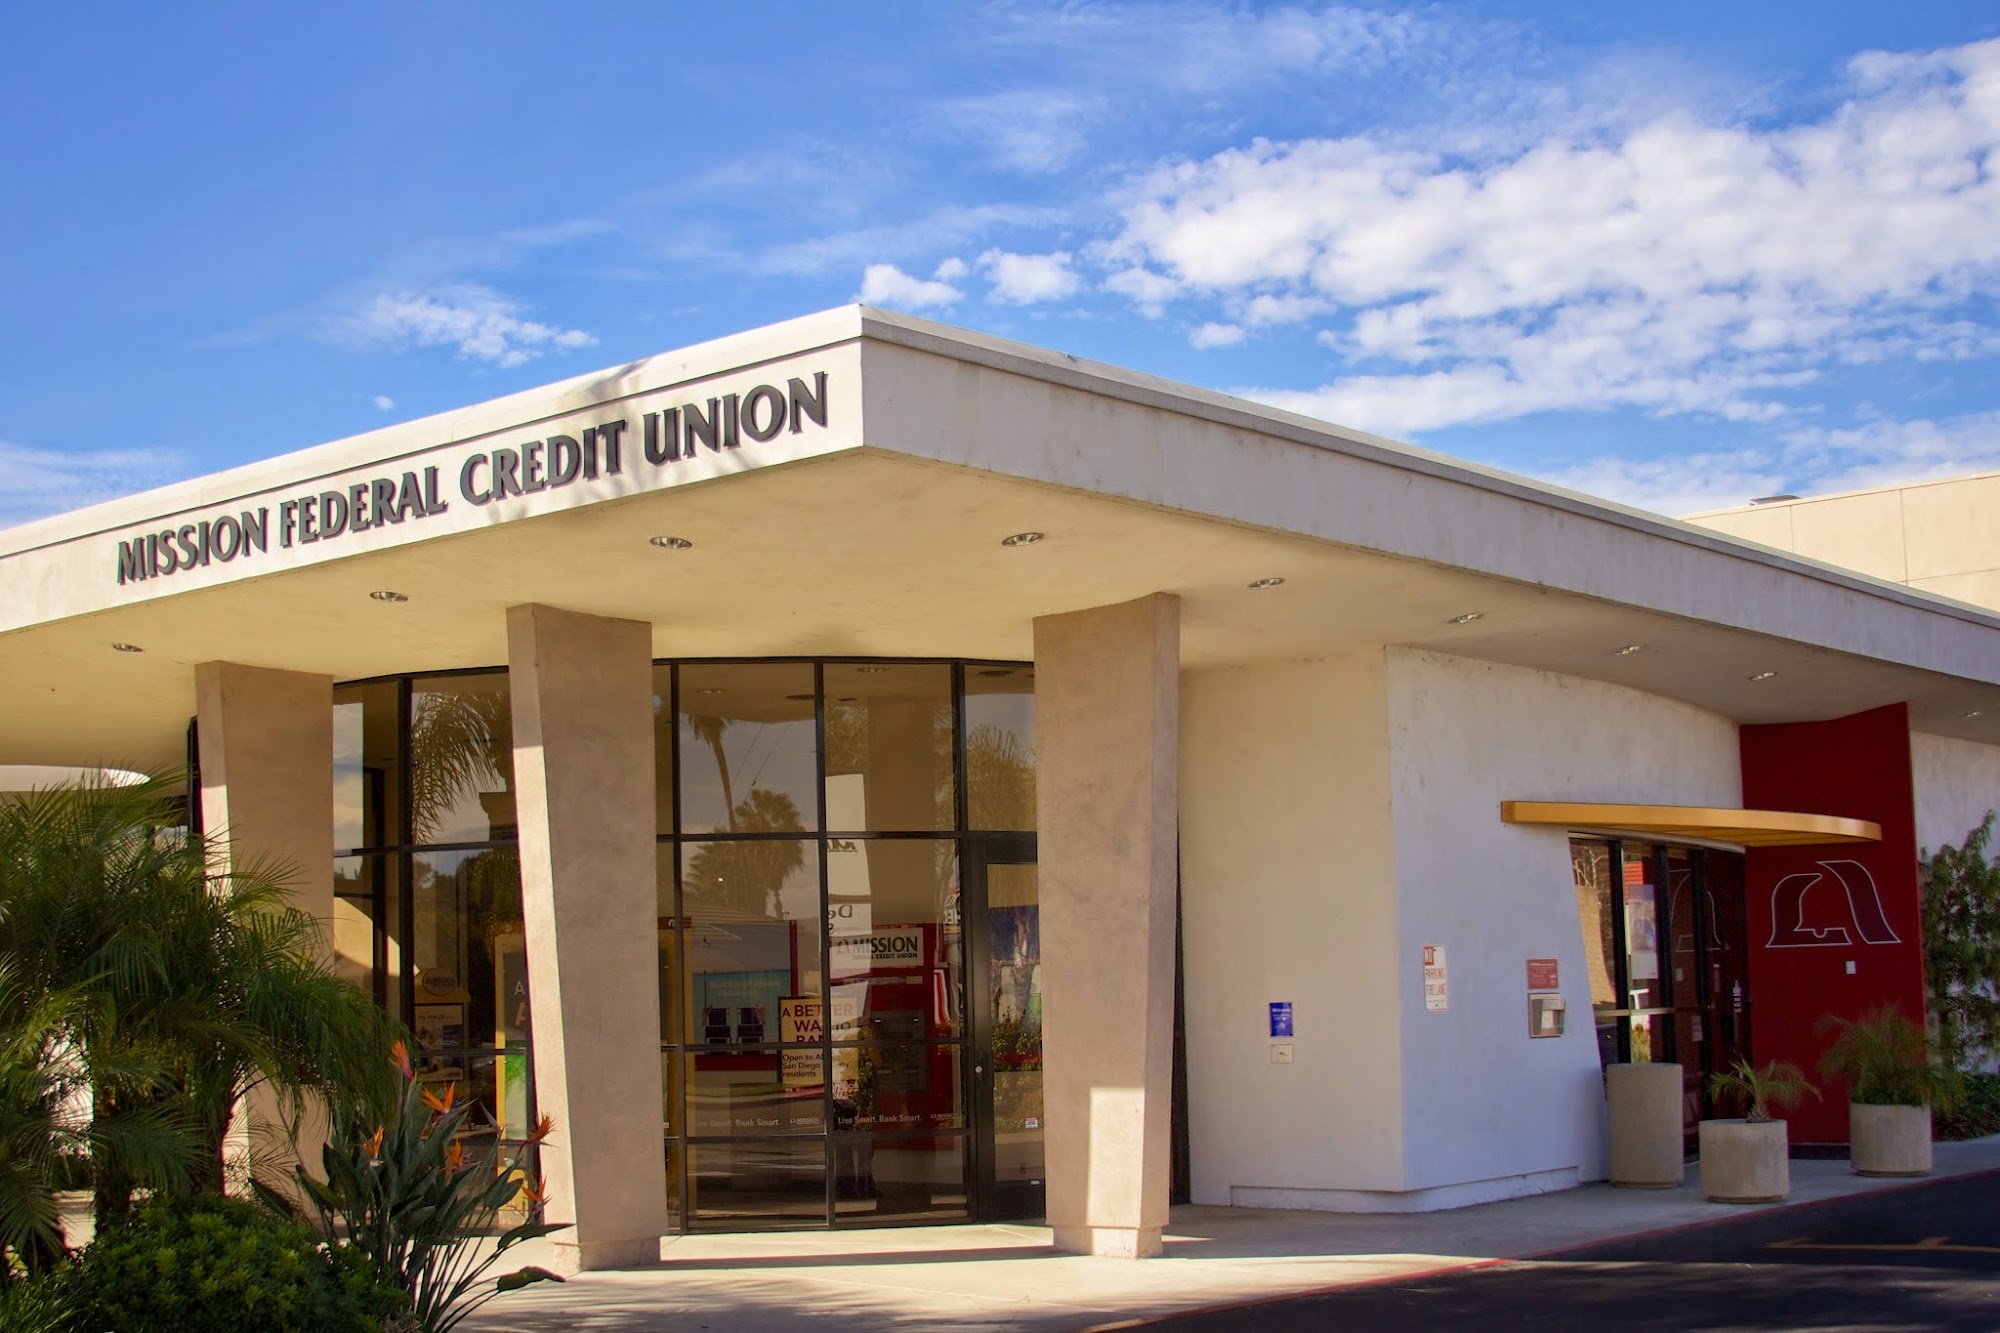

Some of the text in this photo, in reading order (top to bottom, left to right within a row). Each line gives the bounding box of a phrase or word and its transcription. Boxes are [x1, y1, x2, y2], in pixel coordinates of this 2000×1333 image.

[116, 371, 828, 586] MISSION FEDERAL CREDIT UNION
[852, 937, 918, 953] MISSION
[1425, 948, 1434, 963] NO
[1425, 968, 1445, 979] PARKING
[1425, 983, 1446, 995] FIRE LANE
[781, 1004, 854, 1018] A BETER
[782, 1053, 804, 1063] Open
[806, 1053, 815, 1061] to
[782, 1062, 796, 1070] San
[799, 1061, 820, 1070] Diego
[782, 1069, 816, 1078] residents
[735, 1117, 781, 1127] Bank Smart.
[838, 1113, 922, 1124] Live Smart. Bank Smart.
